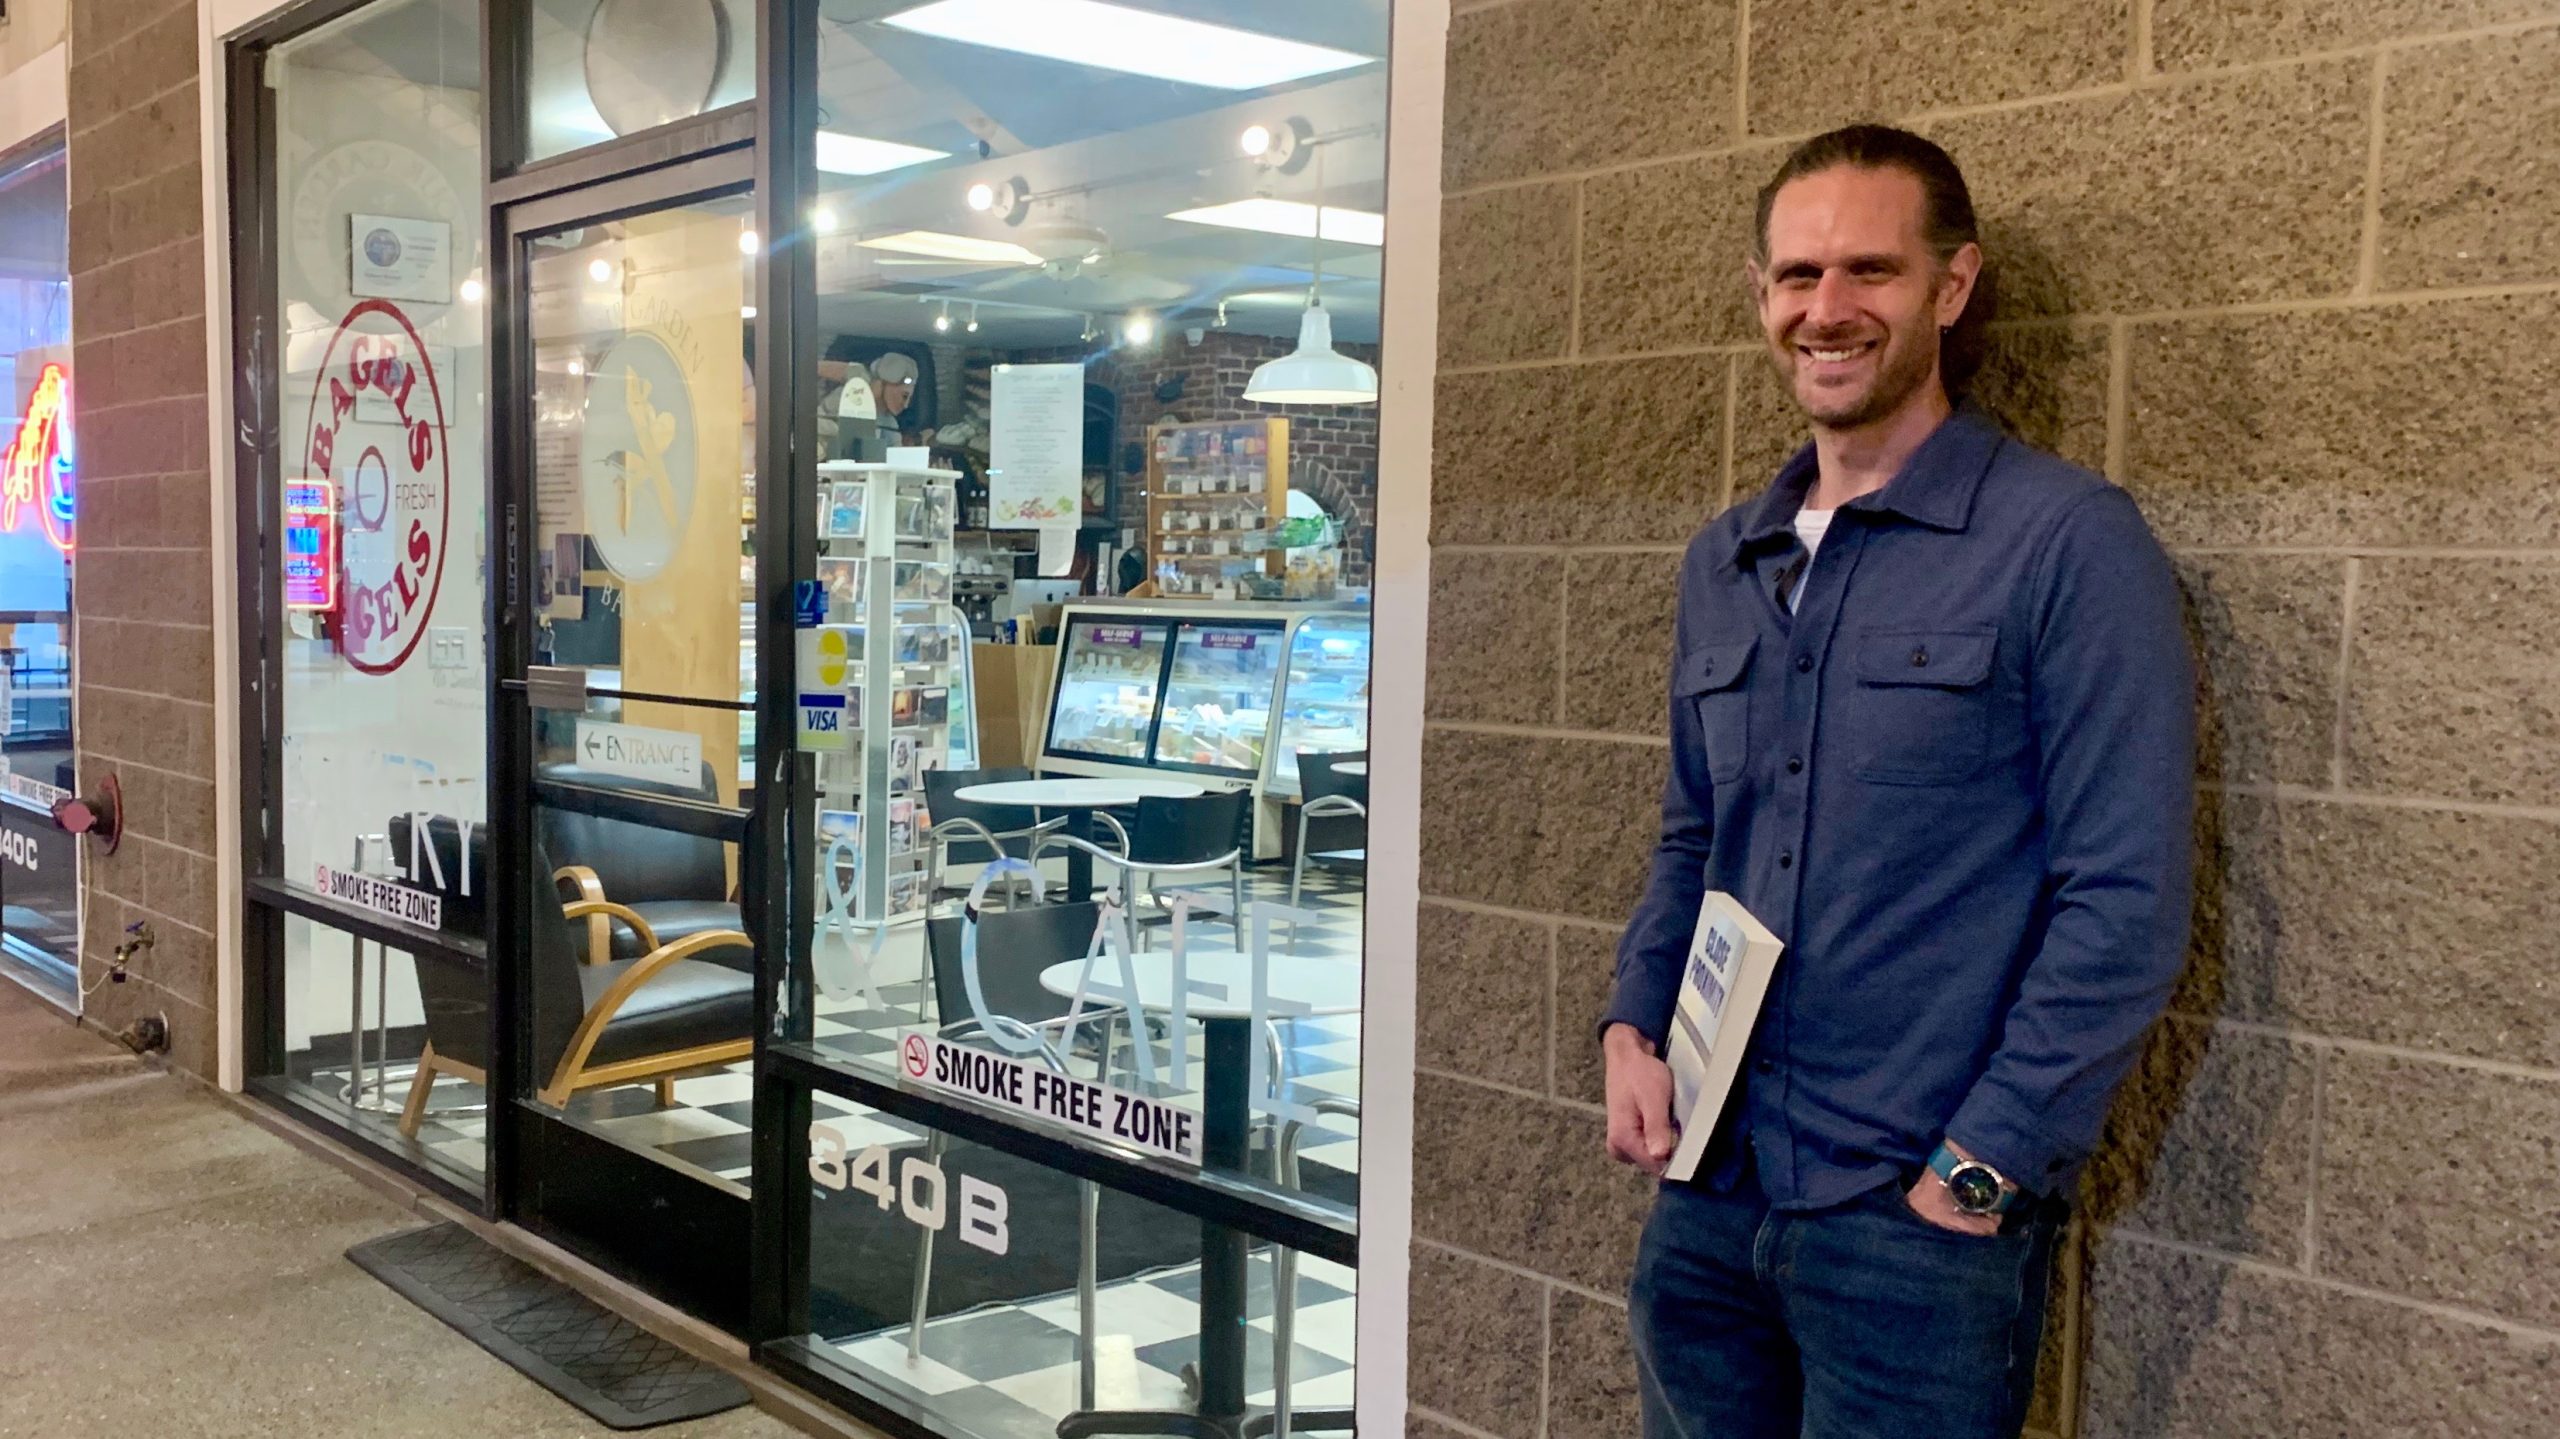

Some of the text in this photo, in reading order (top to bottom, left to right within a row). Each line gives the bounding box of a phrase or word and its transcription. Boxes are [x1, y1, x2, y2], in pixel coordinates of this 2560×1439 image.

[312, 336, 433, 479] BAGELS
[395, 484, 436, 511] FRESH
[807, 710, 838, 731] VISA
[607, 735, 690, 773] ENTRANCE
[0, 826, 38, 871] 40C
[331, 871, 437, 926] SMOKE FREE ZONE
[962, 857, 1319, 1127] CAFE
[935, 1044, 1192, 1157] SMOKE FREE ZONE
